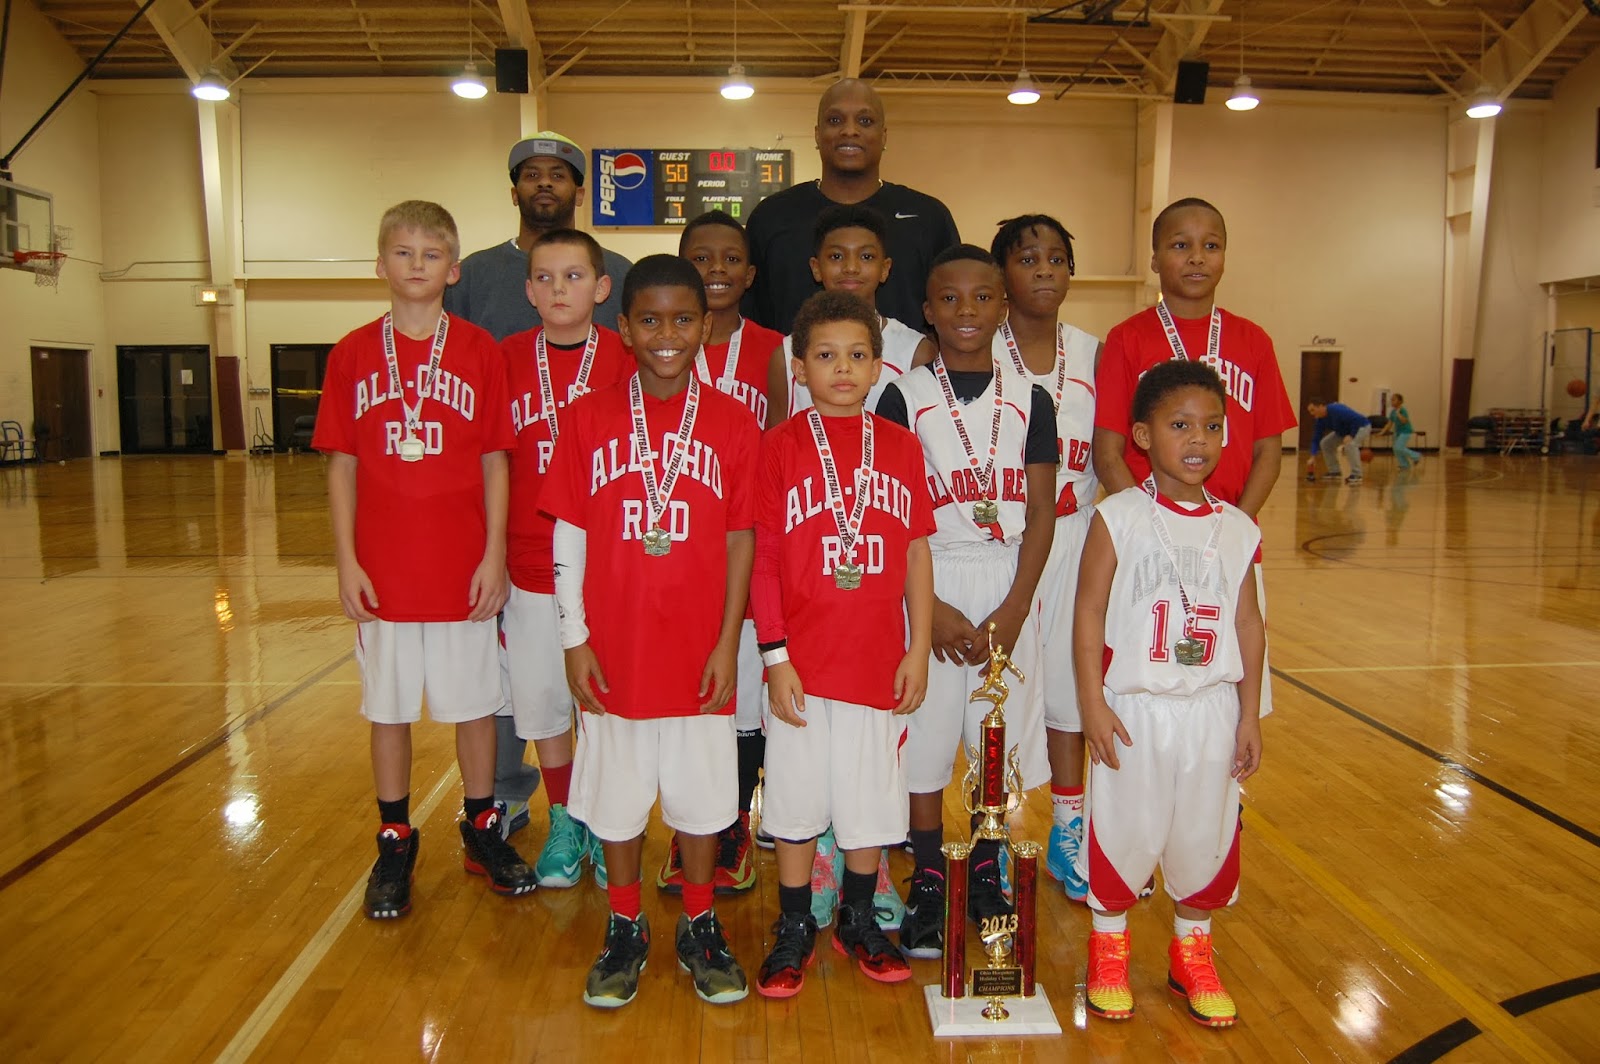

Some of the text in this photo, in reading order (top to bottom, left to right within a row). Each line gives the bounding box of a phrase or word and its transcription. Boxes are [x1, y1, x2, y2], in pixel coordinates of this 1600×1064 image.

[659, 153, 690, 161] GUEST
[666, 164, 688, 182] 50
[755, 153, 784, 161] HOME
[761, 165, 783, 182] 31
[600, 154, 616, 217] PEPSI
[540, 369, 552, 403] BASKETBALL
[579, 351, 594, 384] BASKETBALL
[939, 374, 956, 409] BASKETBALL
[635, 417, 649, 458] BASKETBALL
[680, 403, 696, 442] BASKETBALL
[809, 413, 828, 447] BASKETBALL
[953, 418, 976, 456] BASKETBALL
[991, 408, 1002, 447] BASKETBALL
[863, 430, 873, 468] BASKETBALL
[661, 451, 683, 494] BASKETBALL
[823, 457, 841, 499] BASKETBALL
[853, 478, 869, 520] BASKETBALL
[1149, 599, 1221, 666] 15
[980, 913, 1019, 935] 2013
